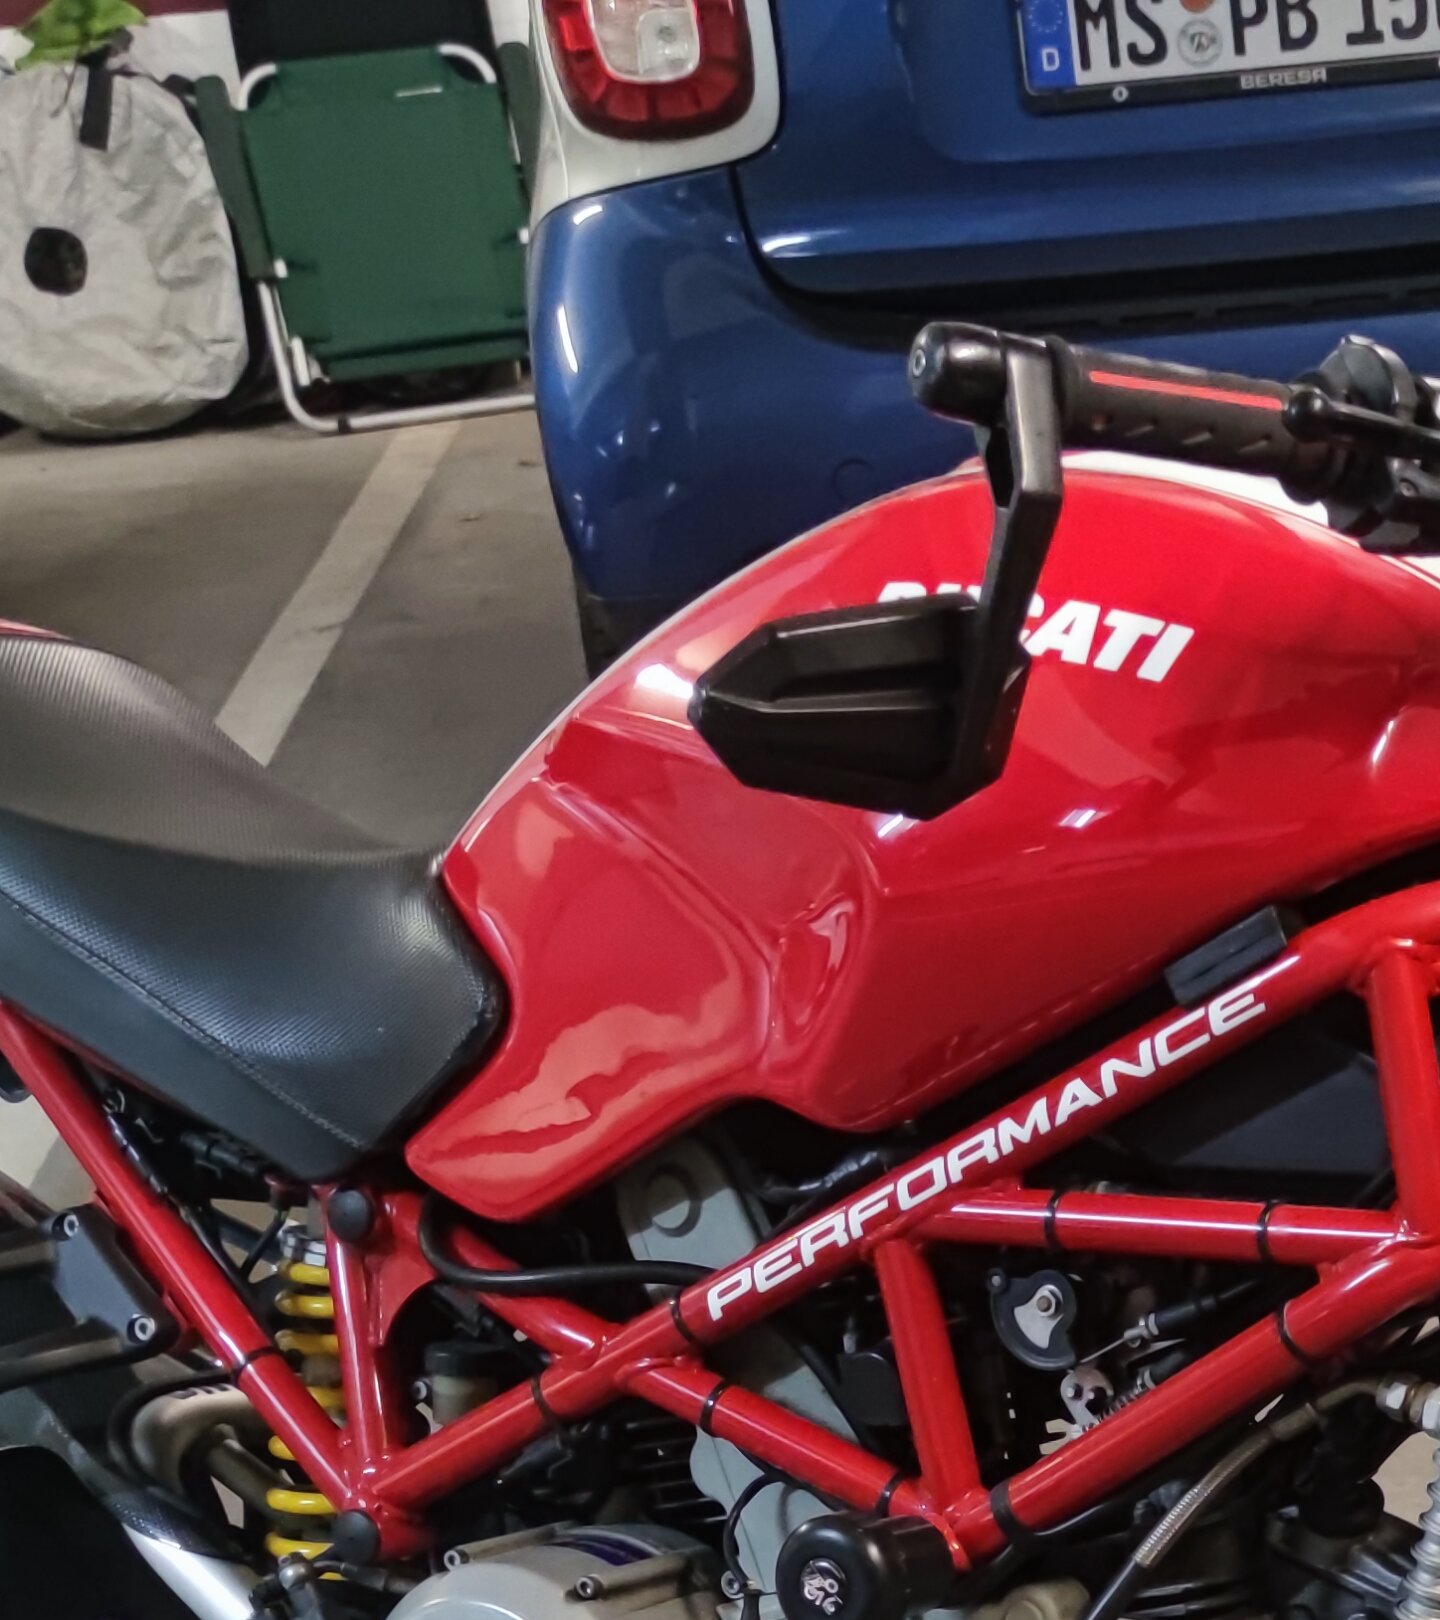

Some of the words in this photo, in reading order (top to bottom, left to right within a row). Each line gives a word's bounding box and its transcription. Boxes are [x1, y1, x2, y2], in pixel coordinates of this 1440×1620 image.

[1073, 0, 1168, 72] MS
[1231, 0, 1319, 56] PB
[1240, 68, 1328, 90] BERESA
[707, 984, 1266, 1321] PERFORMANCE
